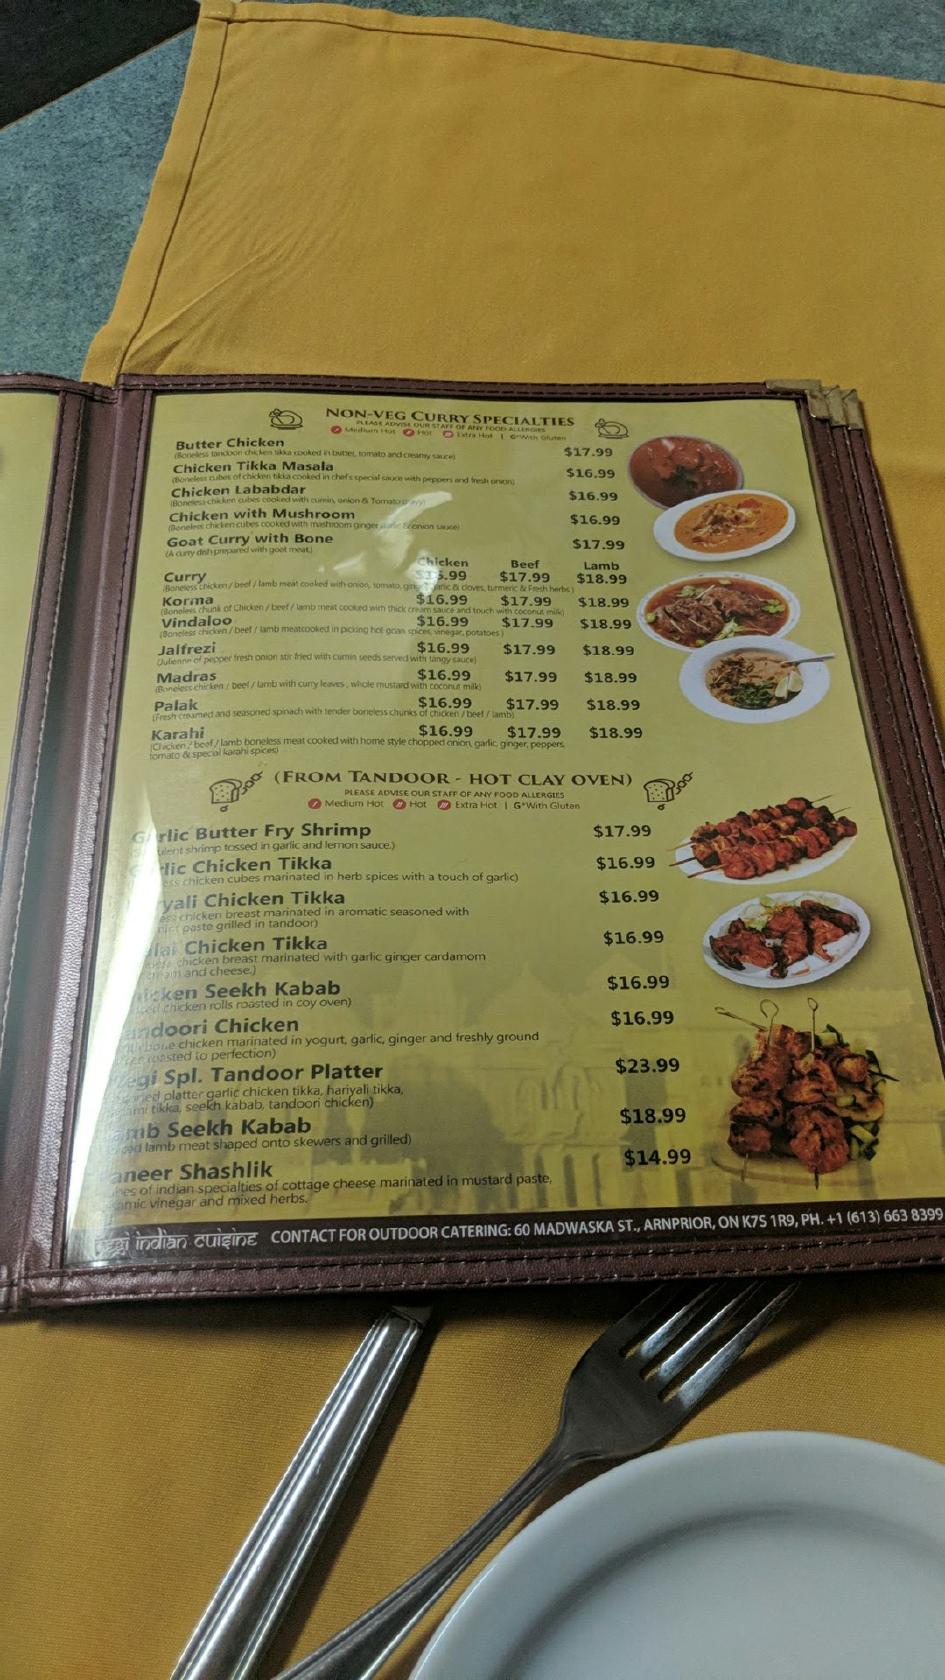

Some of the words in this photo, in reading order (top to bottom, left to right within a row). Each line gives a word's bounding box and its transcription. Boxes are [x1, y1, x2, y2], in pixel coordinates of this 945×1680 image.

[326, 407, 406, 421] NON-VEG
[411, 411, 469, 423] CURRY
[473, 415, 574, 426] SPECIALTIES
[176, 441, 222, 450] Butter
[227, 438, 284, 448] Chicken
[564, 447, 613, 457] $17.99
[173, 462, 231, 474] Chicken
[237, 461, 277, 471] Tikka
[282, 461, 334, 471] Masala
[566, 468, 615, 479] $16.99
[171, 486, 229, 498] Chicken
[235, 485, 306, 495] Lababdar
[569, 491, 618, 501] $16.99
[169, 510, 228, 522] Chicken
[234, 509, 267, 519] with
[272, 509, 355, 519] Mushroom
[571, 515, 620, 525] $16.99
[167, 537, 203, 547] Goat
[208, 535, 250, 547] Curry
[255, 534, 289, 544] with
[295, 534, 333, 544] Bone
[573, 540, 624, 550] $17.99
[417, 557, 468, 567] Chicken
[511, 560, 540, 569] Beef
[584, 562, 619, 571] Lamb
[164, 573, 207, 584] Curry
[500, 572, 550, 583] $17.99
[577, 573, 627, 584] $18.99
[162, 596, 213, 606] Korma
[416, 594, 467, 605] $16.99
[501, 596, 551, 606] $17.99
[578, 597, 629, 608] $18.99
[162, 616, 232, 628] Vindaloo
[417, 616, 468, 627] $16.99
[502, 617, 553, 628] $17.99
[580, 619, 631, 629] $18.99
[158, 642, 216, 655] Jalfrezi
[417, 642, 469, 653] $16.99
[504, 645, 555, 655] $17.99
[583, 646, 634, 656] $18.99
[156, 671, 216, 683] Madras
[418, 669, 470, 681] $16.99
[505, 671, 557, 682] $17.99
[585, 673, 637, 683] $18.99
[154, 699, 198, 712] Palak
[419, 697, 472, 708] $16.99
[507, 699, 559, 710] $17.99
[587, 700, 640, 711] $18.99
[152, 727, 205, 741] Karahi
[419, 726, 473, 736] $16.99
[508, 727, 561, 738] $17.99
[589, 728, 642, 739] $18.99
[244, 737, 281, 746] boneless
[284, 737, 305, 745] meat
[307, 737, 338, 745] cooked
[340, 737, 358, 745] with
[361, 737, 385, 745] home
[275, 770, 341, 784] (FROM
[348, 770, 450, 784] TANDOOR
[469, 773, 511, 786] HOT
[518, 773, 565, 786] CLAY
[572, 774, 632, 786] OVEN)
[325, 799, 363, 808] Medium
[367, 800, 384, 808] Hot
[455, 801, 478, 809] Extra
[480, 801, 498, 809] Hot
[132, 829, 188, 843] Grlic
[196, 827, 257, 840] Butter
[264, 825, 294, 839] Fry
[301, 823, 371, 839] Shrimp
[593, 825, 651, 838] $17.99
[185, 844, 221, 855] shrimp
[224, 842, 257, 851] tossed
[272, 842, 300, 851] garlic
[302, 841, 322, 849] and
[325, 841, 358, 849] lemon
[360, 840, 395, 851] sauce.)
[193, 858, 270, 873] Chicken
[278, 857, 332, 870] Tikka
[596, 857, 655, 870] $16.99
[183, 876, 224, 886] chicken
[227, 874, 260, 883] cubes
[263, 872, 320, 882] marinated
[324, 872, 334, 880] in
[337, 872, 362, 881] herb
[366, 872, 399, 882] spices
[402, 873, 426, 882] with
[438, 873, 469, 882] touch
[472, 873, 483, 882] of
[486, 872, 519, 884] garlic)
[205, 892, 283, 907] Chicken
[291, 891, 345, 905] Tikka
[599, 890, 660, 903] $16.99
[603, 931, 664, 945] $16.99
[185, 940, 265, 956] Chicken
[272, 937, 328, 951] Tikka
[205, 982, 267, 998] Seekh
[276, 980, 340, 996] Kabab
[607, 976, 669, 990] $16.99
[611, 1010, 674, 1026] $16.99
[120, 1019, 207, 1040] andoori
[215, 1017, 299, 1034] Chicken
[616, 1058, 680, 1074] $23.99
[164, 1068, 202, 1085] Spl.
[211, 1066, 303, 1083] Tandoor
[311, 1064, 383, 1080] Platter
[620, 1108, 686, 1124] $18.99
[111, 1121, 160, 1141] amb
[167, 1120, 232, 1138] Seekh
[241, 1117, 311, 1135] Kabab
[145, 1141, 175, 1153] lamb
[179, 1141, 210, 1151] meat
[214, 1139, 259, 1152] shaped
[262, 1139, 290, 1148] onto
[294, 1137, 341, 1147] skewers
[345, 1135, 368, 1146] and
[371, 1134, 411, 1147] grilled)
[624, 1149, 691, 1165] $14.99
[107, 1166, 172, 1184] aneer
[180, 1161, 272, 1181] Shashlik
[271, 1229, 337, 1244] CONTACT
[339, 1228, 366, 1242] FOR
[369, 1226, 437, 1241] OUTDOOR
[441, 1222, 512, 1238] CATERING:
[515, 1223, 530, 1237] 60
[534, 1220, 614, 1236] MADWASKA
[618, 1219, 640, 1235] ST.,
[644, 1216, 716, 1233] ARNPRIOR,
[718, 1215, 739, 1229] ON
[743, 1214, 766, 1229] K7S
[771, 1213, 798, 1230] 1R9,
[801, 1212, 823, 1226] PH.
[827, 1211, 842, 1225] +1
[847, 1210, 880, 1226] (613)
[884, 1209, 907, 1222] 663
[911, 1208, 944, 1222] 8399
